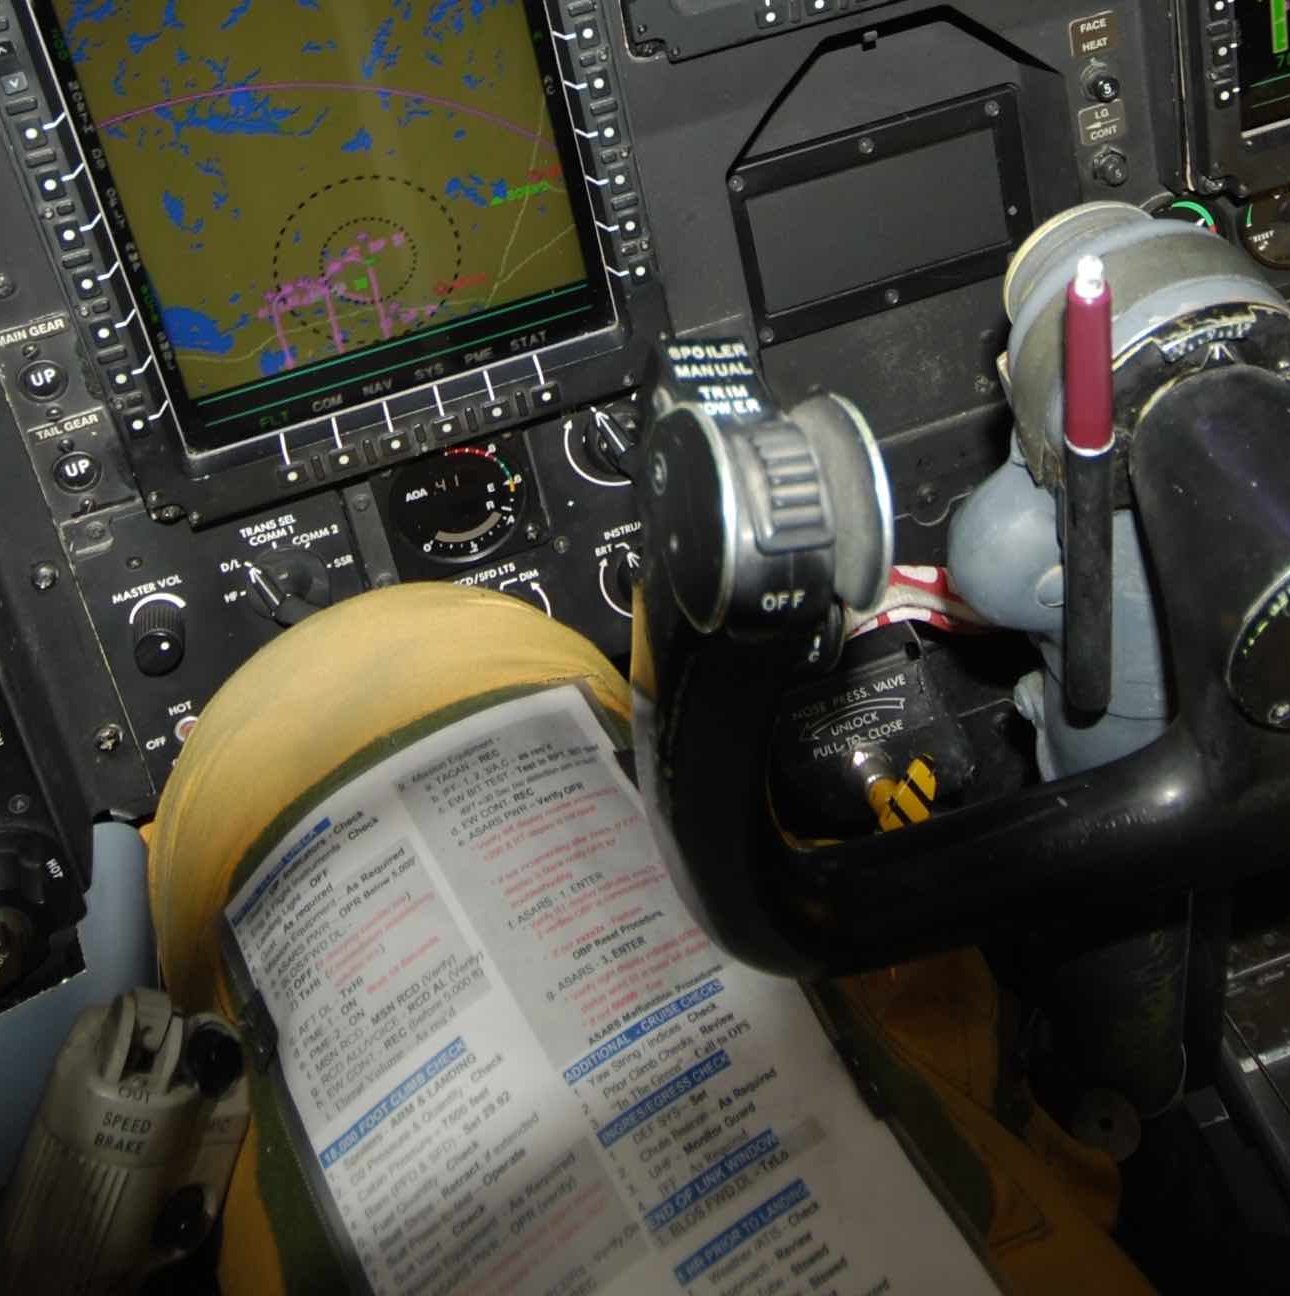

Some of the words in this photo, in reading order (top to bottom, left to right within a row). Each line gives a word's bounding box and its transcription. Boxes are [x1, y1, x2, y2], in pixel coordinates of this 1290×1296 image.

[1079, 18, 1108, 34] FACE
[1081, 37, 1108, 53] HEAT
[1094, 107, 1110, 120] LG
[1089, 124, 1118, 141] CONT
[29, 318, 66, 337] GEAR
[667, 344, 748, 362] SPOILER
[30, 367, 56, 387] UP
[312, 394, 344, 413] COM
[362, 379, 394, 397] NAV
[414, 363, 445, 381] SYS
[509, 330, 549, 352] STAT
[673, 363, 754, 381] MANUAL
[698, 384, 749, 401] TRIM
[35, 425, 64, 441] TAIL
[63, 413, 100, 433] GEAR
[64, 458, 90, 478] UP
[405, 487, 429, 503] AOA
[238, 521, 272, 540] TRANS
[273, 514, 296, 531] SEL
[248, 529, 287, 548] COMM
[287, 526, 294, 536] 1
[291, 529, 330, 547] COMM
[329, 524, 340, 536] 2
[595, 543, 613, 558] BRT
[220, 560, 242, 573] D/L
[333, 555, 354, 569] SSR
[497, 562, 517, 575] LTS
[518, 568, 540, 583] DIM
[111, 584, 156, 606] MASTER
[157, 574, 183, 590] VOL
[223, 591, 238, 604] HF
[760, 588, 806, 613] OFF
[872, 672, 907, 695] VALVE
[168, 701, 193, 717] HOT
[829, 710, 880, 737] UNLOCK
[146, 736, 167, 751] OFF
[45, 857, 64, 881] HOT
[610, 934, 647, 960] ENTER
[561, 1031, 633, 1085] ADDITIONAL
[638, 1000, 682, 1035] CRUISE
[677, 975, 725, 1011] CHECKS
[698, 1008, 736, 1038] Review
[422, 1037, 468, 1078] CHECK
[689, 1049, 731, 1083] CHECK
[731, 1063, 779, 1102] Required
[102, 1111, 152, 1135] SPEED
[93, 1134, 146, 1156] BRAKE
